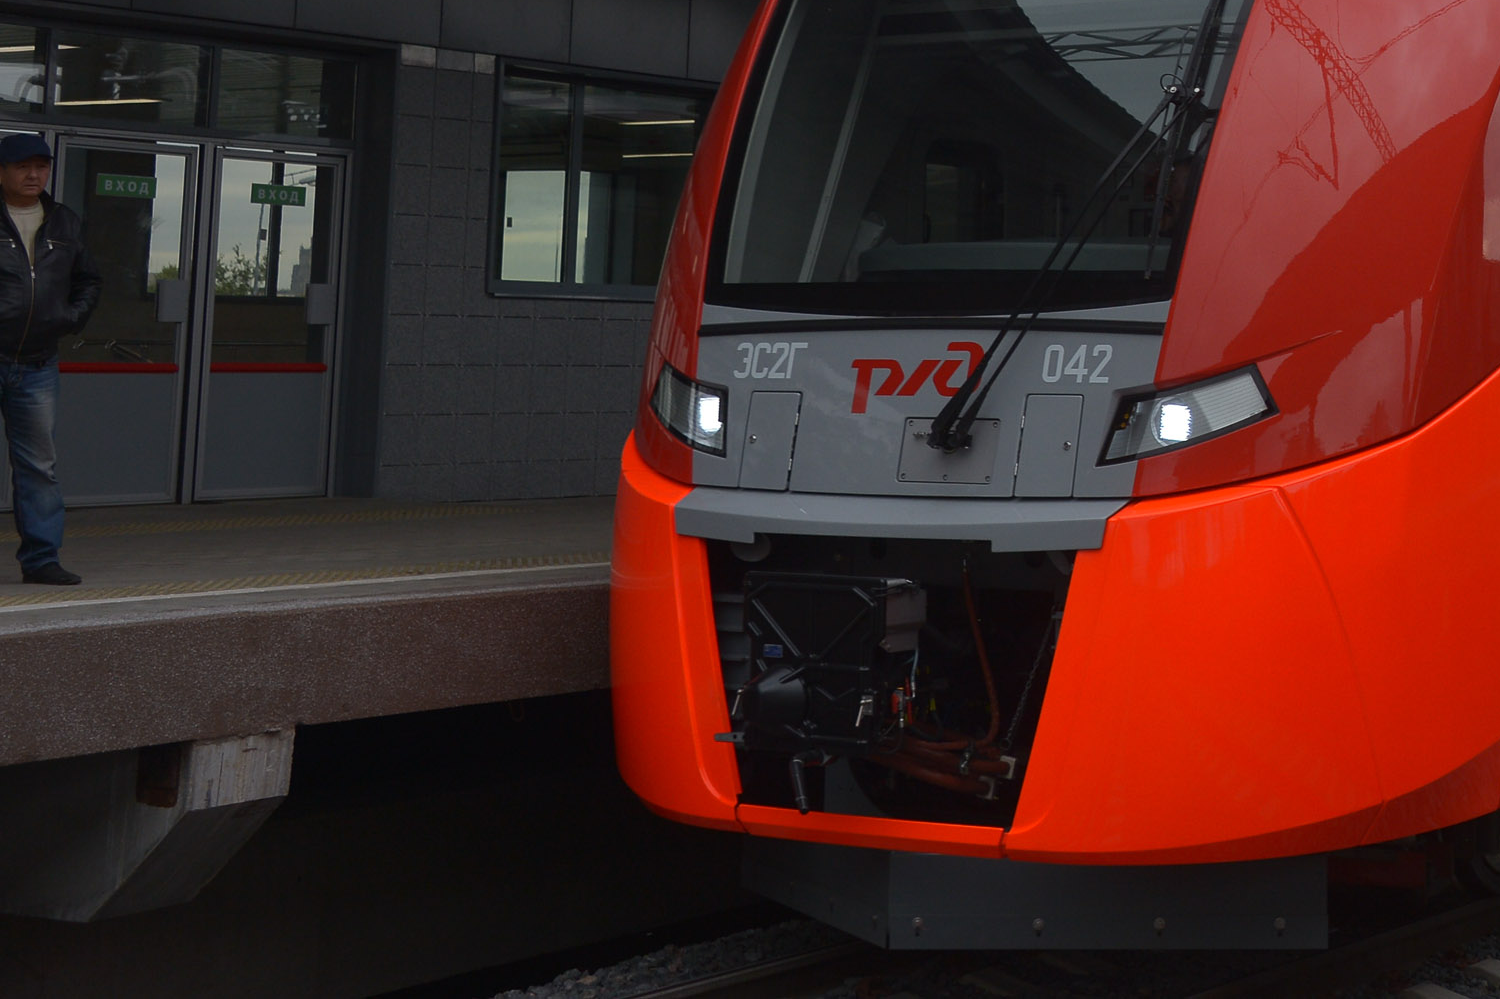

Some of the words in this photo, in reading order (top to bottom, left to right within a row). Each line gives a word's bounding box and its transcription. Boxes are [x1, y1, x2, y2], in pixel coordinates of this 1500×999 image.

[104, 179, 150, 195] ВХОД
[257, 189, 299, 203] ВХОД
[733, 342, 809, 379] ЭС2Г
[1041, 344, 1113, 383] 042
